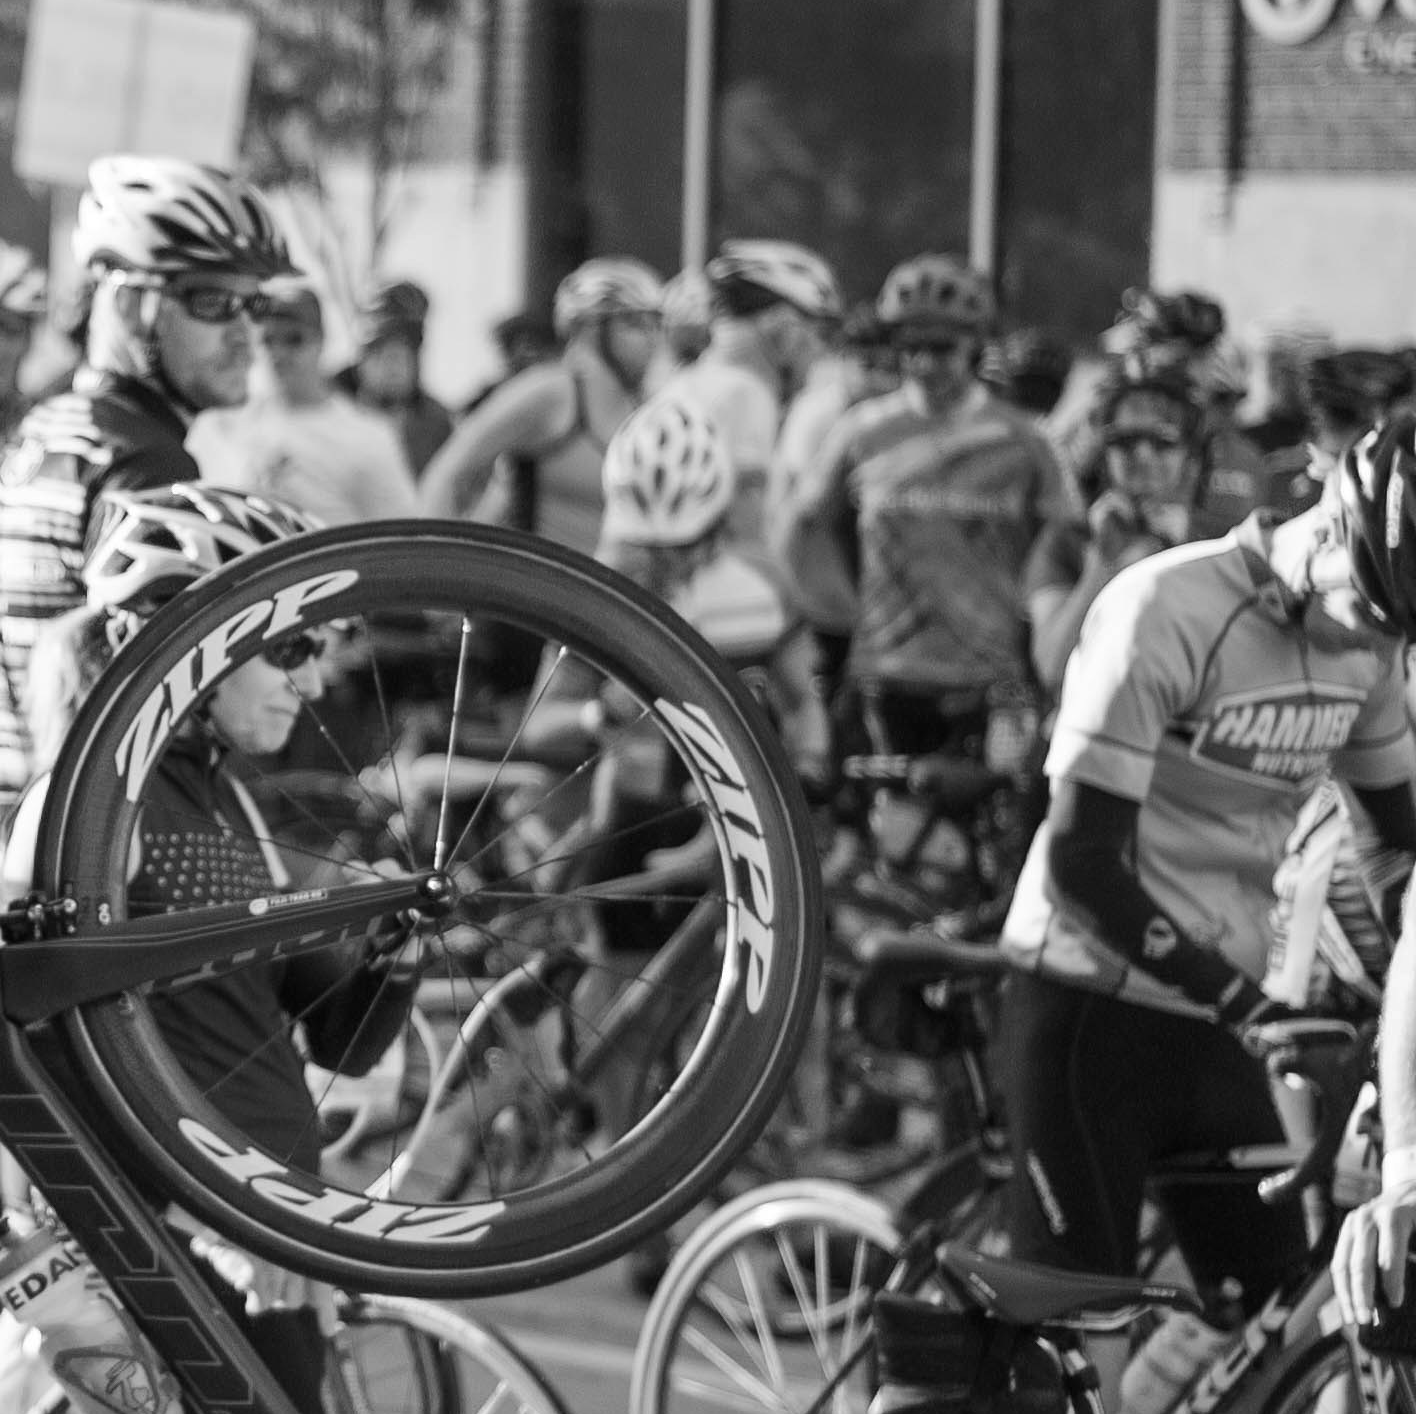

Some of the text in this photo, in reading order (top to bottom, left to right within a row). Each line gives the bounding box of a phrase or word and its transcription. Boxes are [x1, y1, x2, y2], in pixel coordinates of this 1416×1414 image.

[114, 569, 360, 803] ZIPP
[1212, 701, 1361, 751] HAMMER
[653, 696, 775, 1015] ZIPP
[177, 1116, 506, 1243] ZIPP
